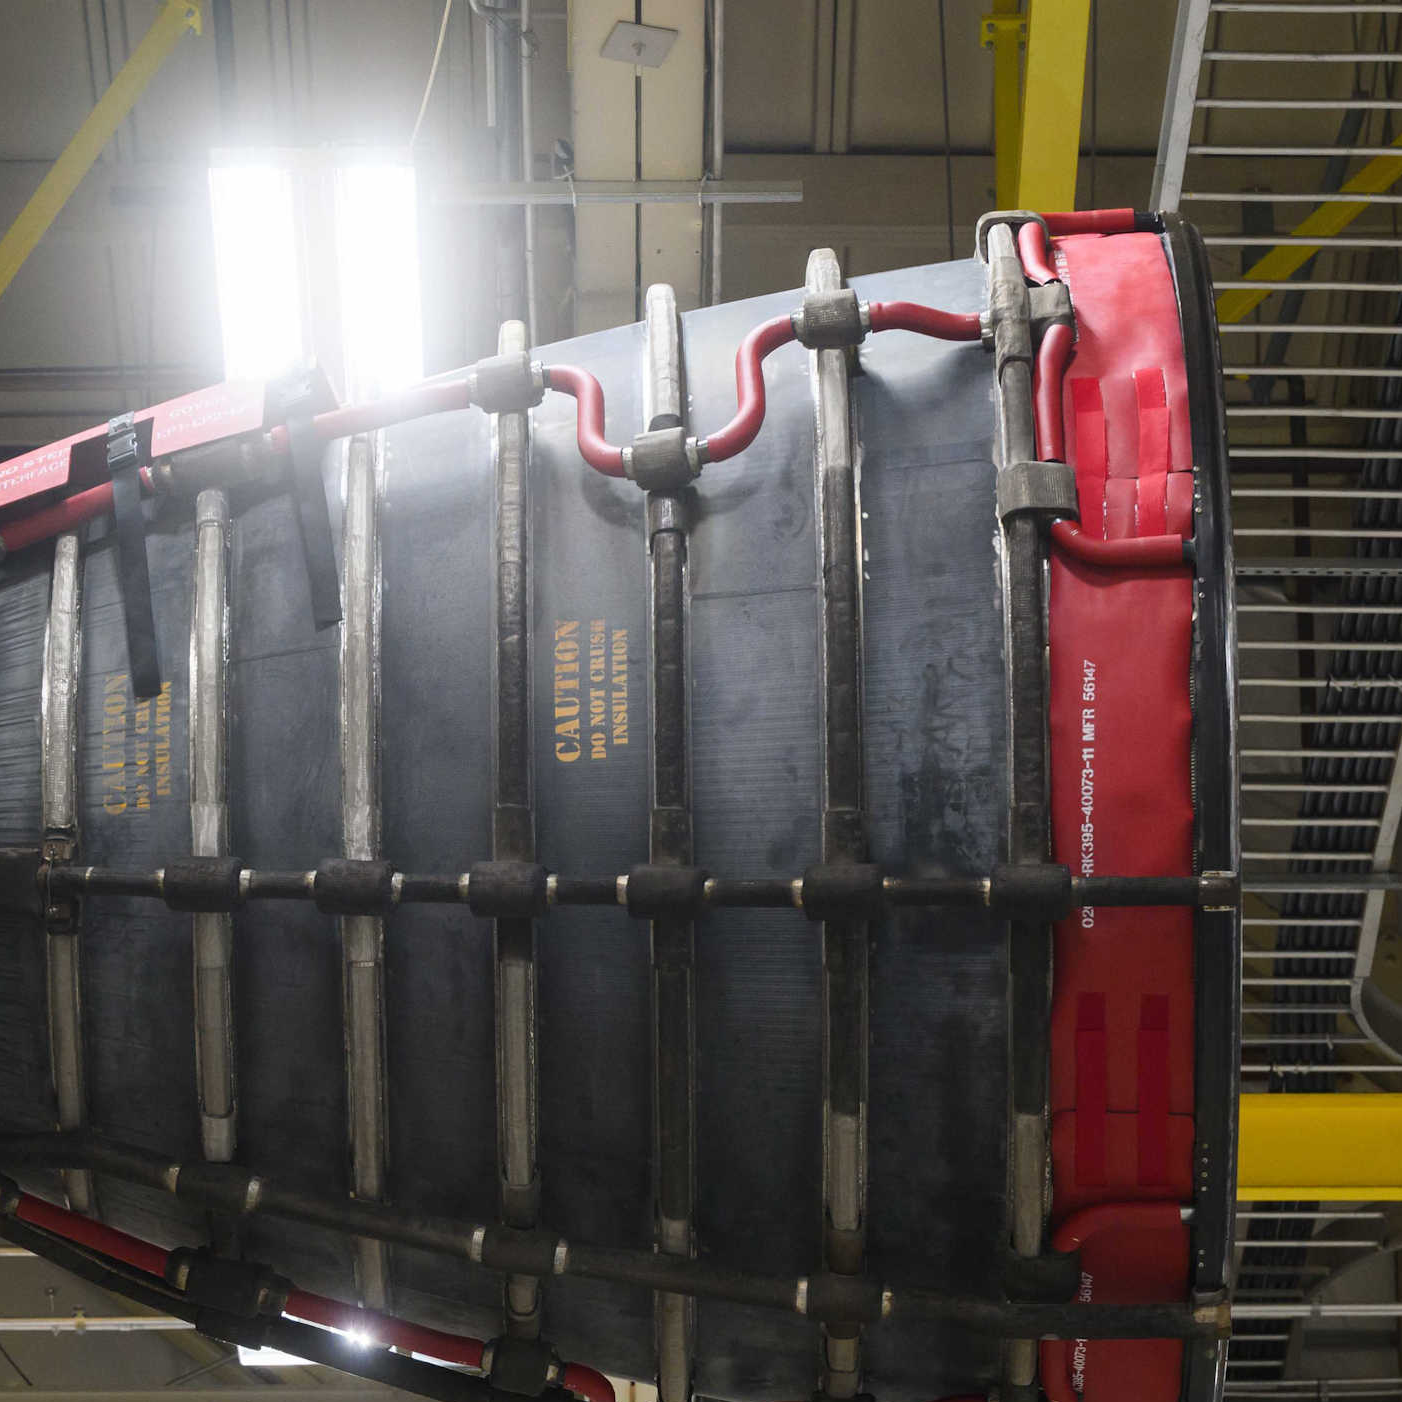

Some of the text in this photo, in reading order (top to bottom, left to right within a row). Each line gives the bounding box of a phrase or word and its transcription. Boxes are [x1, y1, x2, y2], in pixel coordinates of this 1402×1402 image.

[555, 619, 581, 763] CAUTION
[589, 617, 607, 760] DO NOT CRUSH
[612, 629, 629, 745] INSULATION
[1082, 660, 1096, 702] 56147
[102, 675, 127, 815] CAUTION
[1082, 709, 1095, 741] MFR
[136, 742, 150, 777] NOT
[136, 784, 151, 809] DO
[1078, 1272, 1094, 1304] 56147
